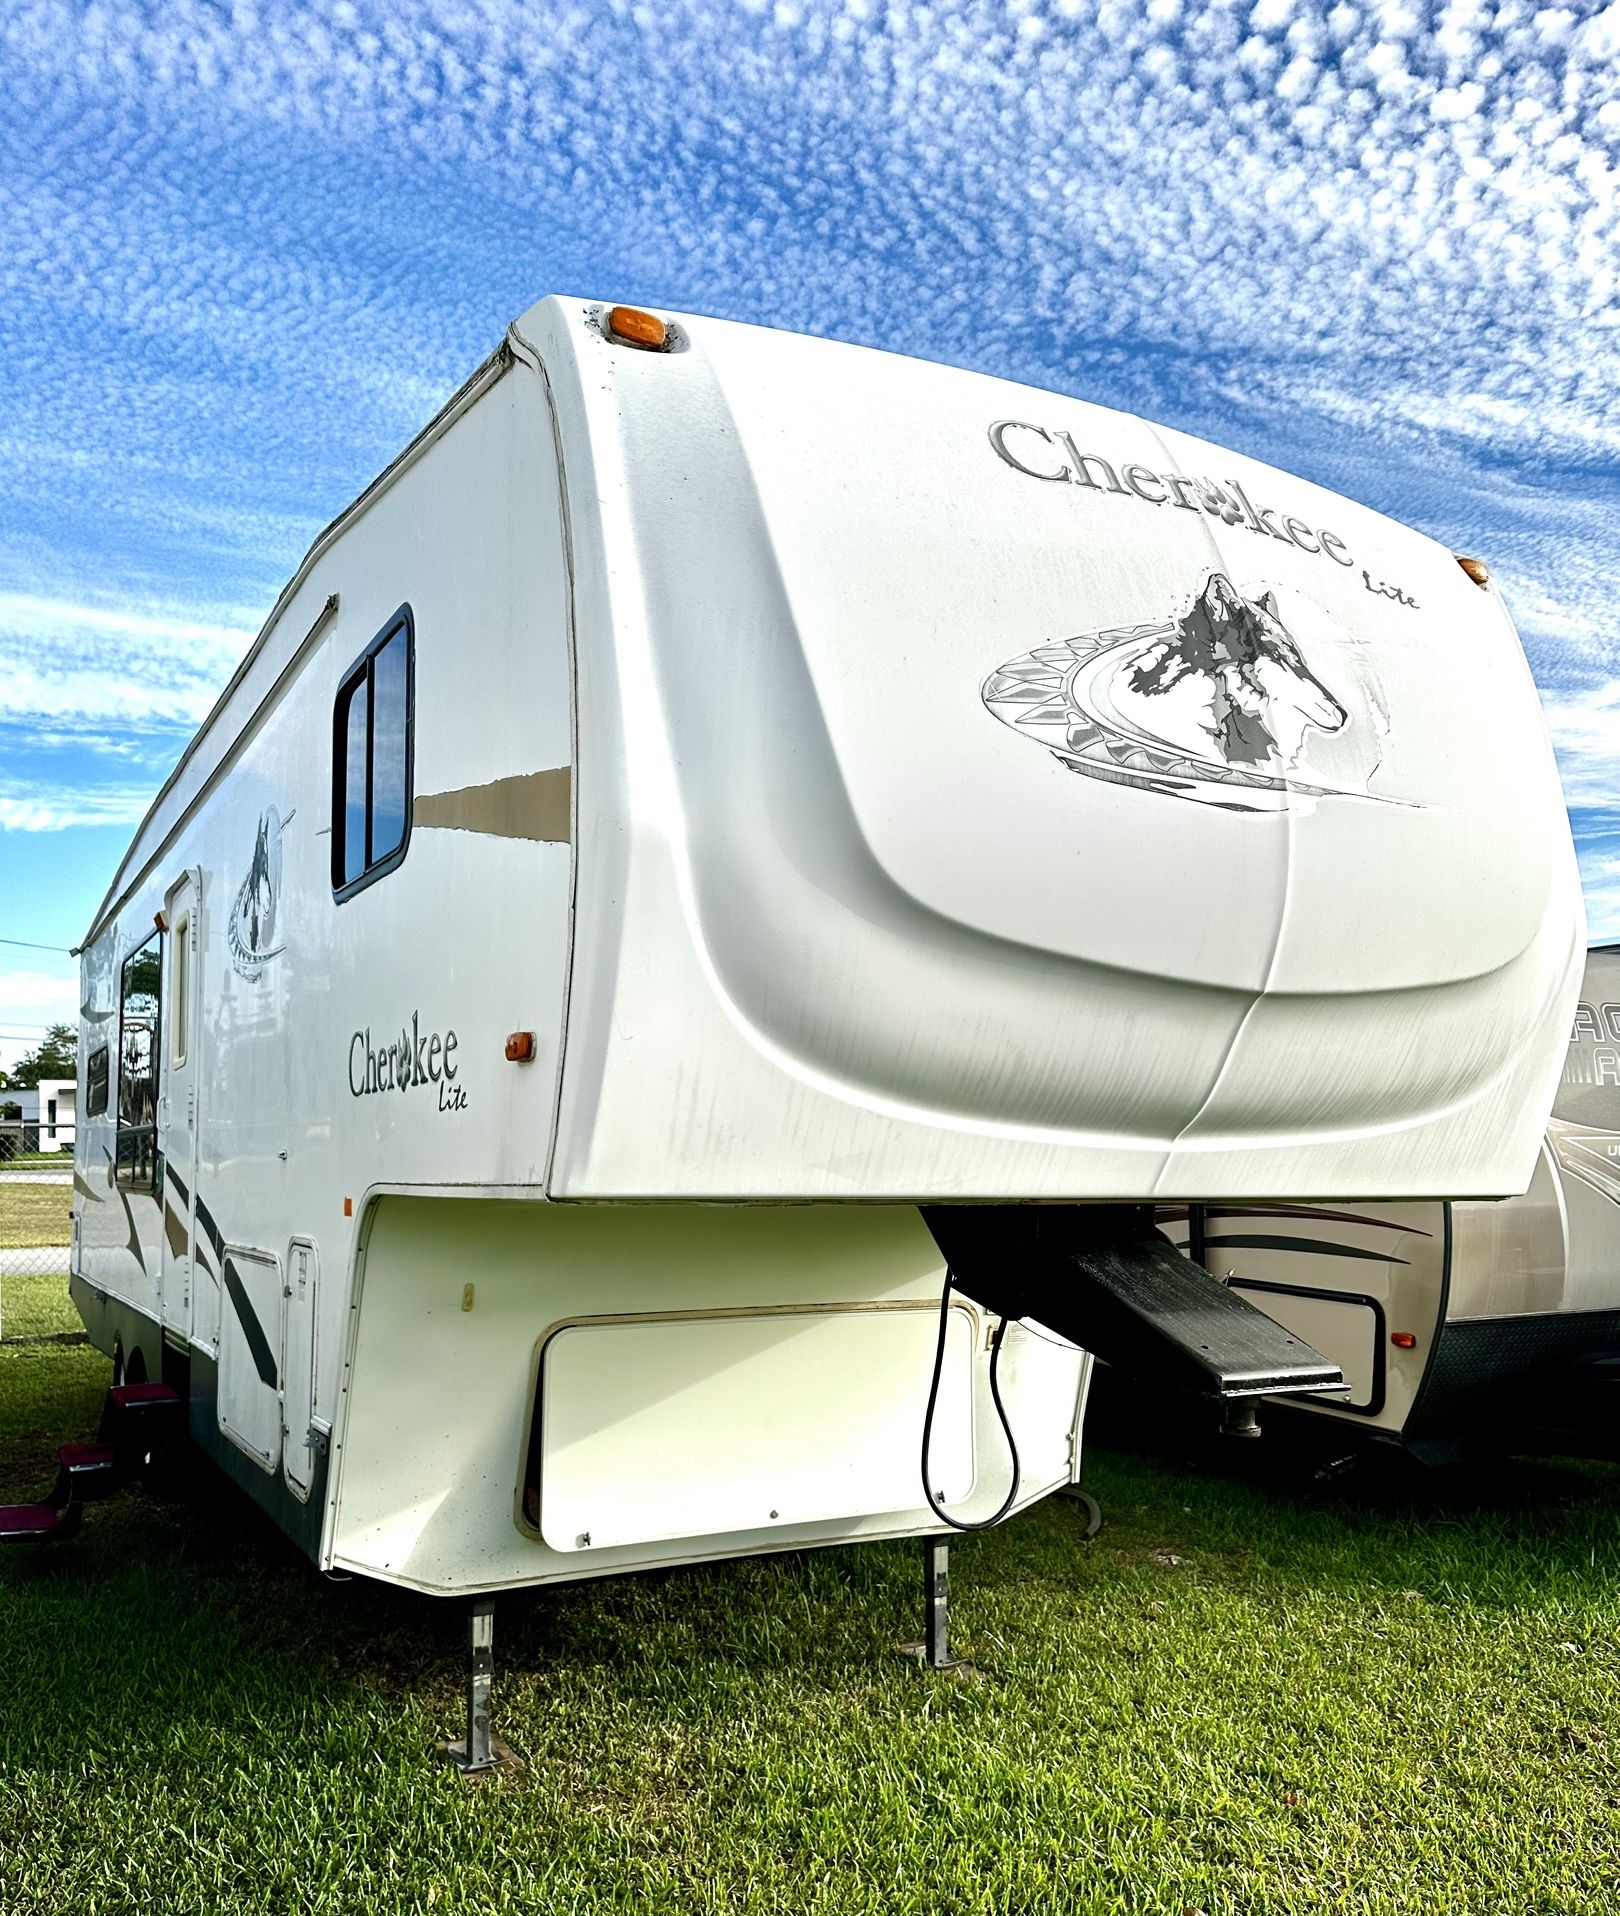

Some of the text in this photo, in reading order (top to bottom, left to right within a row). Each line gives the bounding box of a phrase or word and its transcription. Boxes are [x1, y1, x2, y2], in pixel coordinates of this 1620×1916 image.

[987, 420, 1420, 609] Cherokee Lite
[349, 1009, 458, 1097] Cherokee
[438, 1080, 468, 1112] Lite
